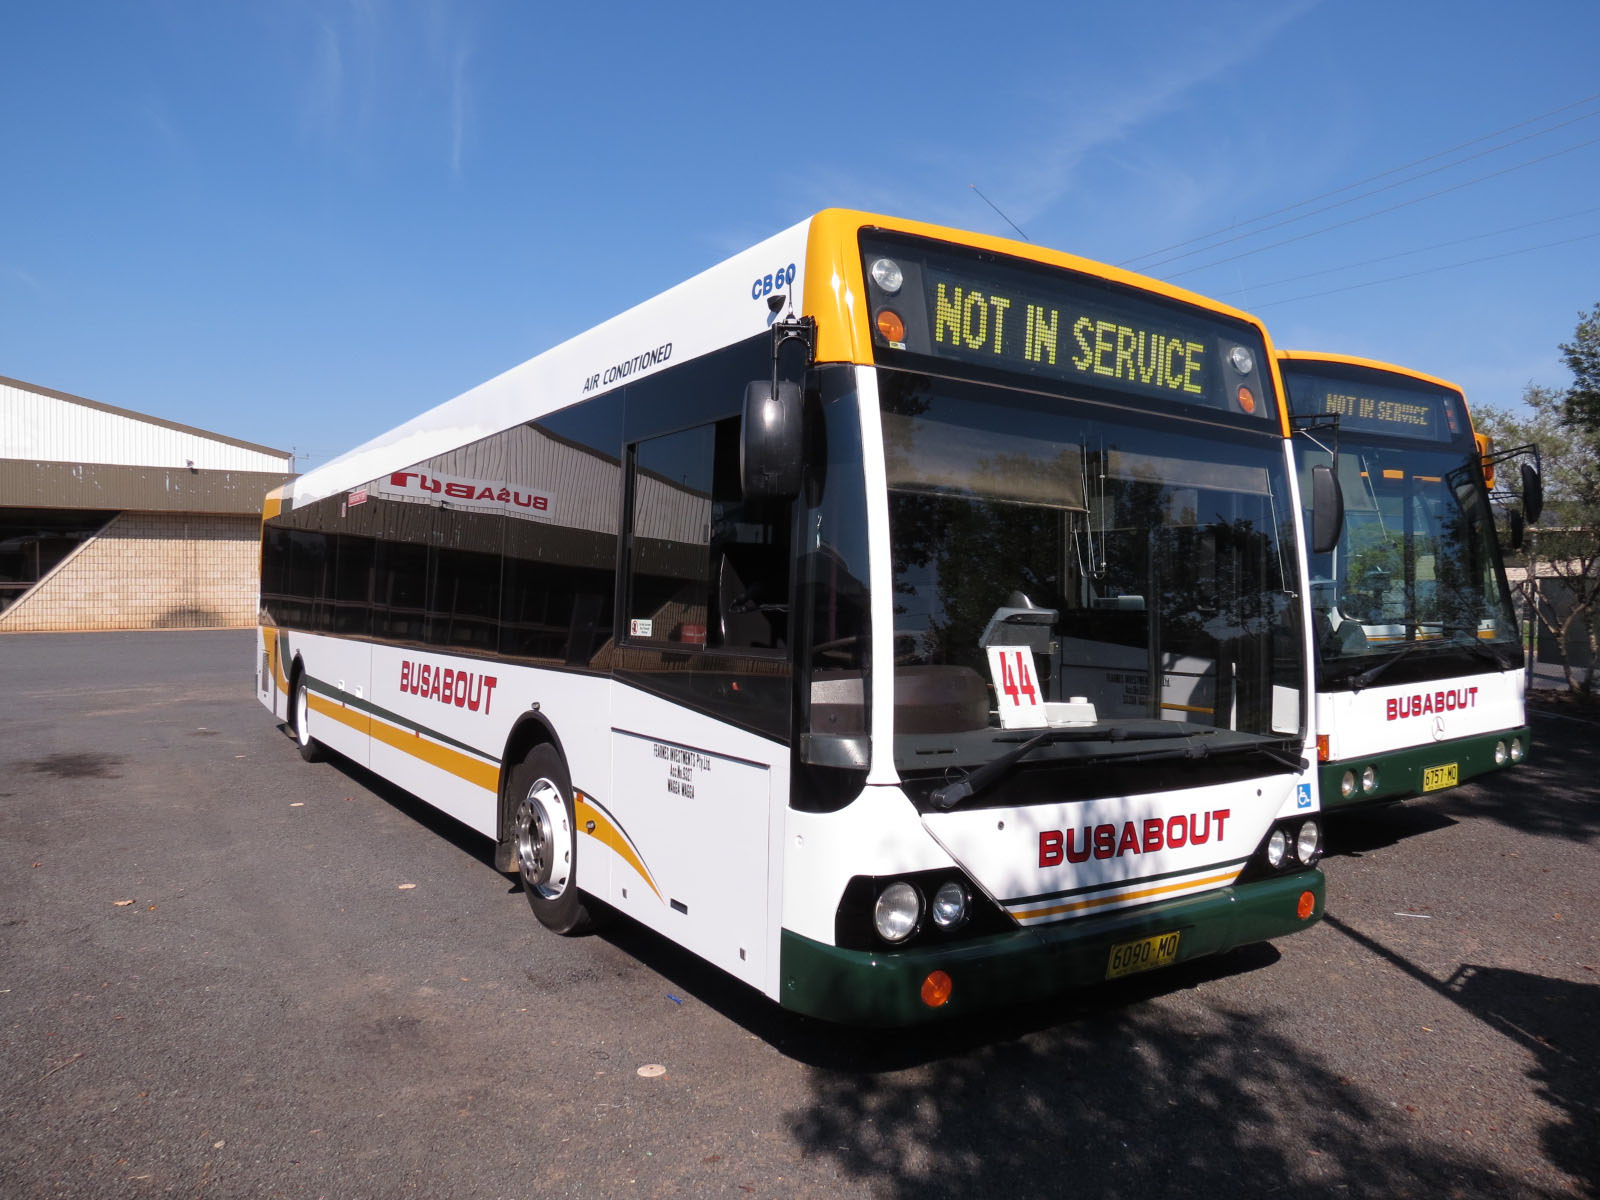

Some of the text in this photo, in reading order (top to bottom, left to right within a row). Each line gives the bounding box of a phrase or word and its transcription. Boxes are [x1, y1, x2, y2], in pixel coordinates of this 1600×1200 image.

[935, 283, 1204, 394] NOT IN SERVICE
[582, 342, 673, 394] AIR CONDITIONED
[1326, 393, 1429, 425] NOT IN SERVICE
[400, 660, 498, 715] BUSABOUT
[999, 651, 1037, 707] 44
[1386, 687, 1479, 721] BUSABOUT
[670, 747, 695, 767] INVESTMENTS
[668, 779, 694, 799] WAGGA WAGGA
[1039, 809, 1231, 868] BUSABOUT
